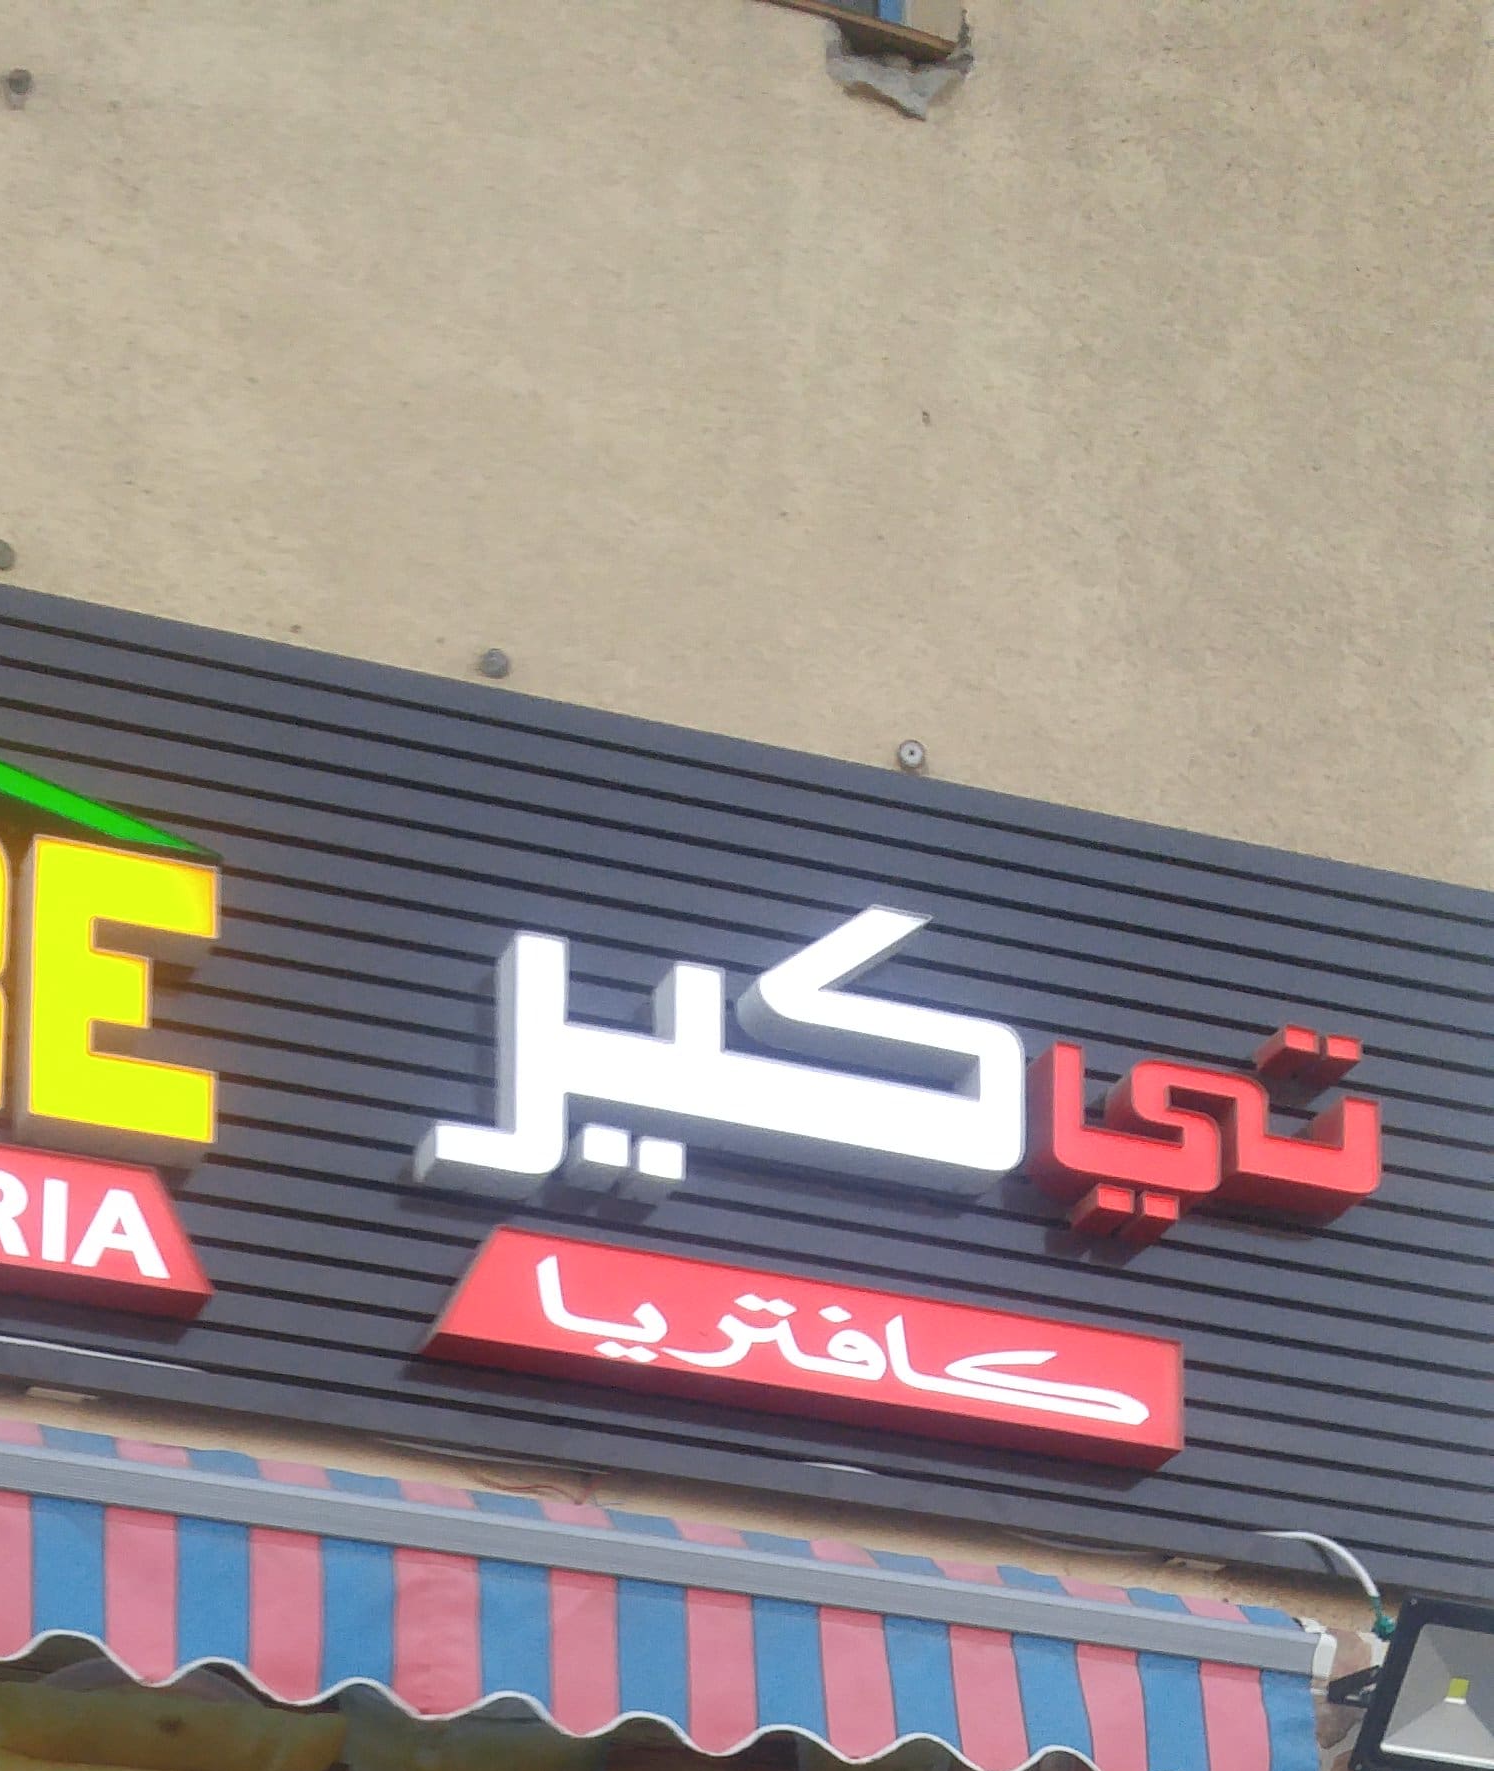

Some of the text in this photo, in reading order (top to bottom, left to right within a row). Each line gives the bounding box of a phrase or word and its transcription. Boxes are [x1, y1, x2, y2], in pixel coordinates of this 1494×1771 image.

[428, 904, 1382, 1214] تي كير
[535, 1254, 1151, 1428] كافتريا
